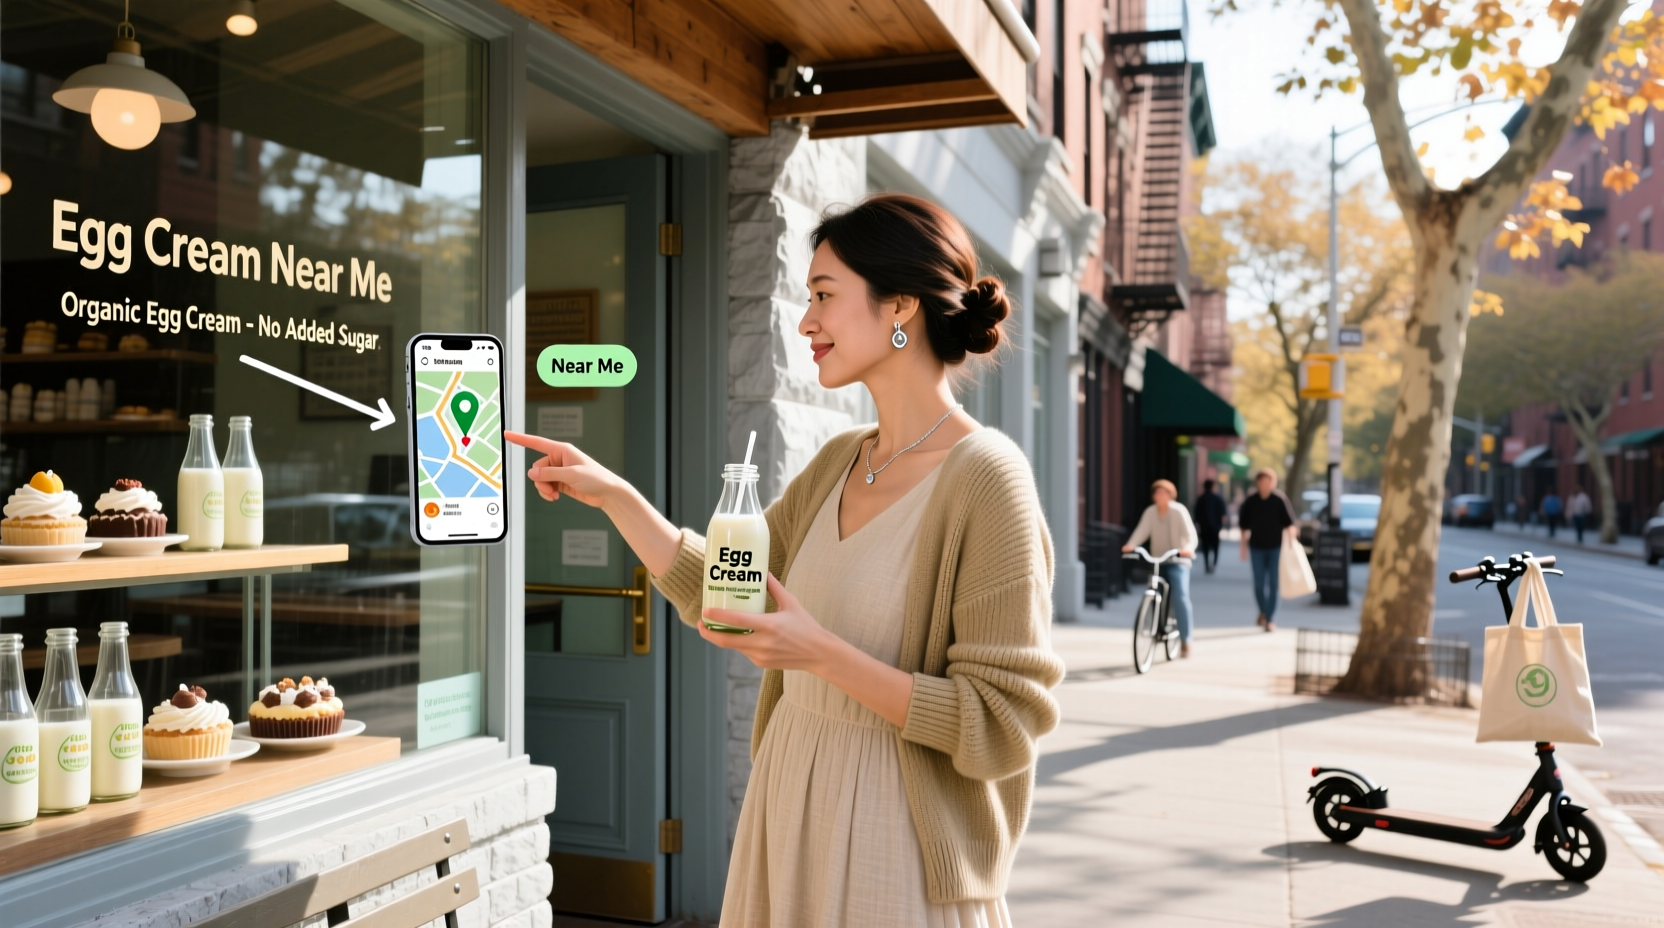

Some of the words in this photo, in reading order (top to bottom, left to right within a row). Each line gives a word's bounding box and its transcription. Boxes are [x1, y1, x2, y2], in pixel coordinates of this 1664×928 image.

[52, 199, 132, 274] Egg
[144, 217, 261, 281] Cream
[271, 241, 344, 294] Near
[350, 257, 392, 303] Me
[60, 291, 141, 326] Organic
[146, 301, 182, 334] Egg
[185, 305, 241, 334] Cream
[258, 314, 281, 338] No
[285, 317, 335, 345] Added
[709, 565, 762, 582] Cream
[719, 547, 752, 567] Egg
